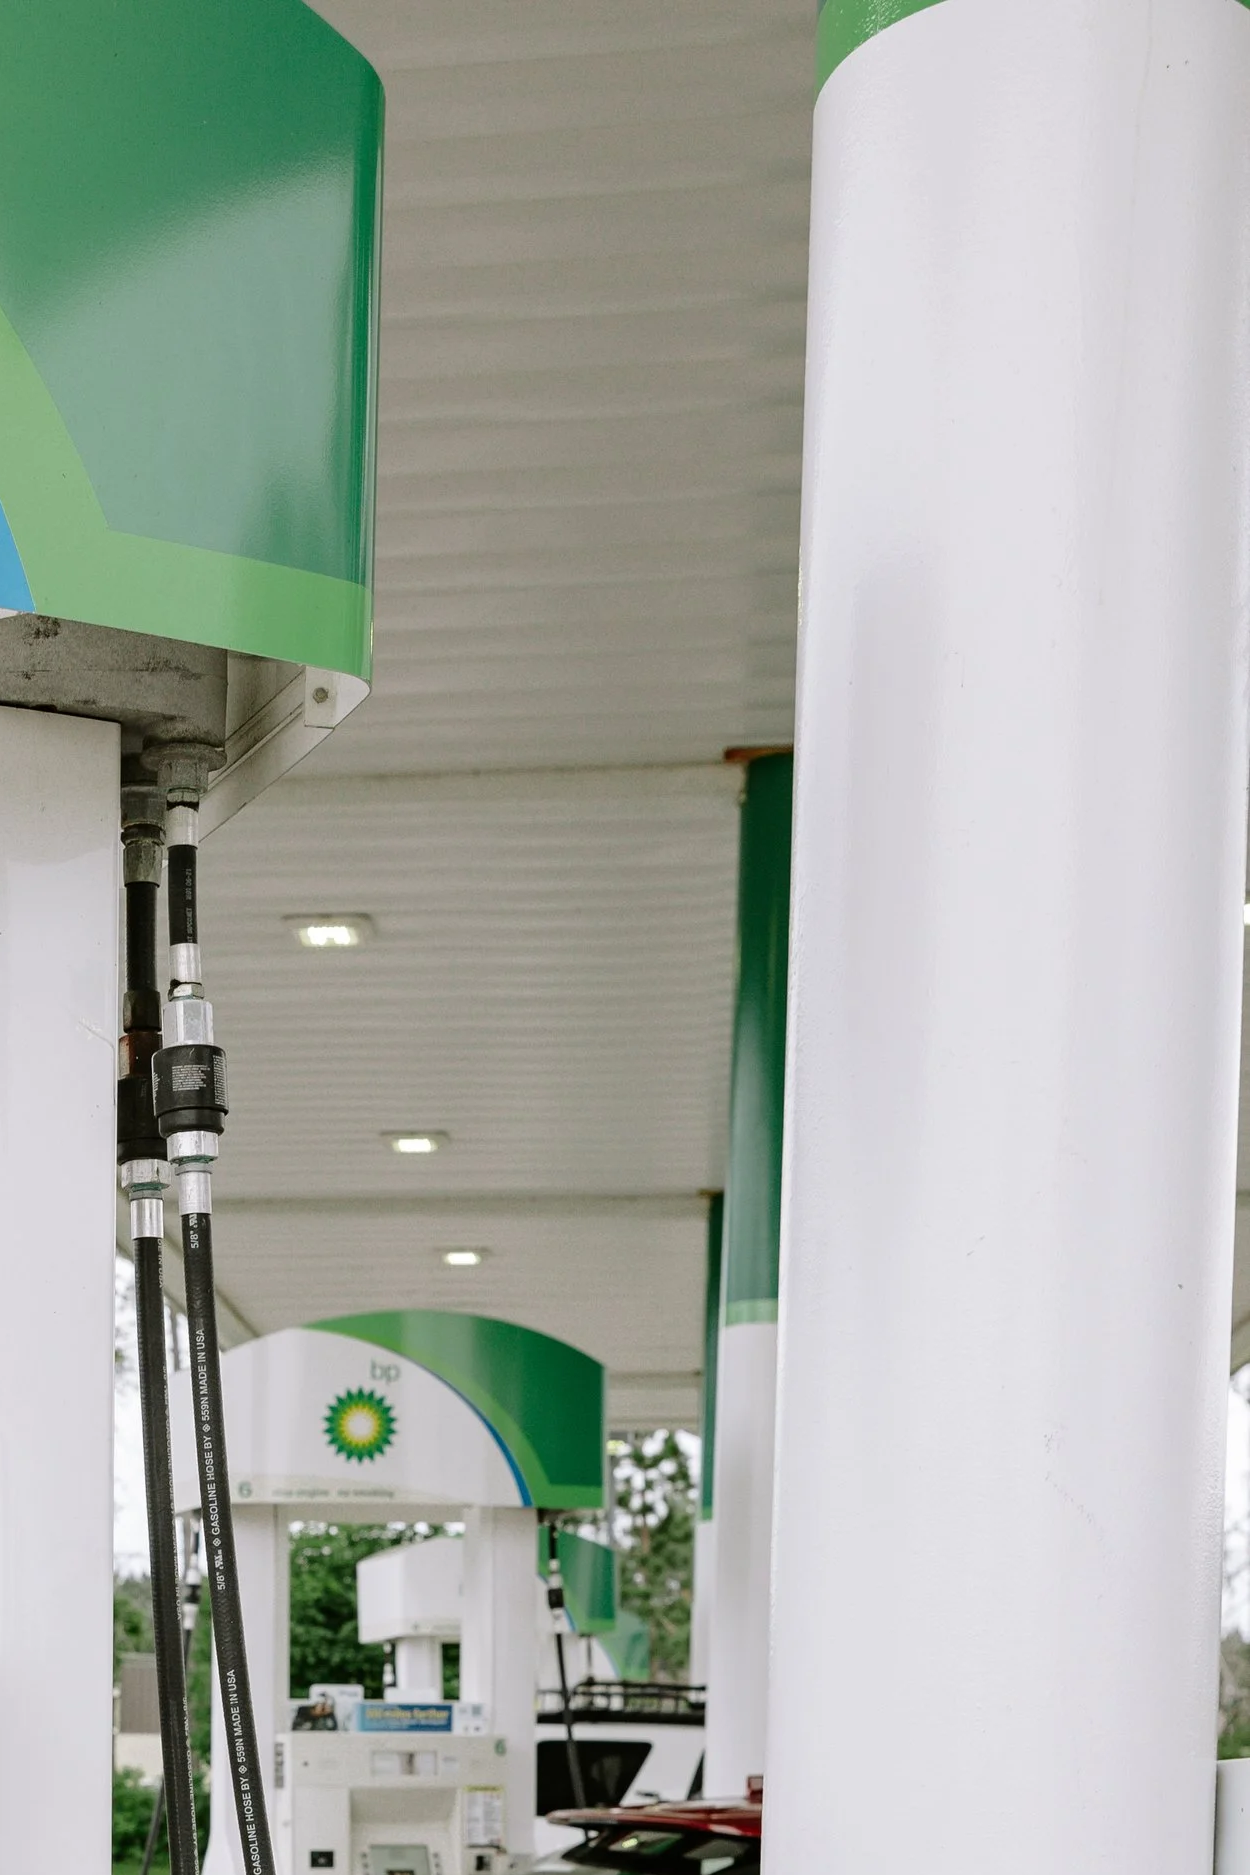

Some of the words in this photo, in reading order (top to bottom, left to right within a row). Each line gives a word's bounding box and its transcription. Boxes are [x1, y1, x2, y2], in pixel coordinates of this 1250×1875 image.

[196, 1329, 205, 1349] USA
[198, 1352, 205, 1362] IN
[198, 1365, 208, 1393] MADE
[370, 1360, 400, 1384] bp
[201, 1397, 210, 1421] 559N
[204, 1436, 212, 1449] BY
[205, 1451, 214, 1480] HOSE
[207, 1482, 221, 1535] GASOLINE
